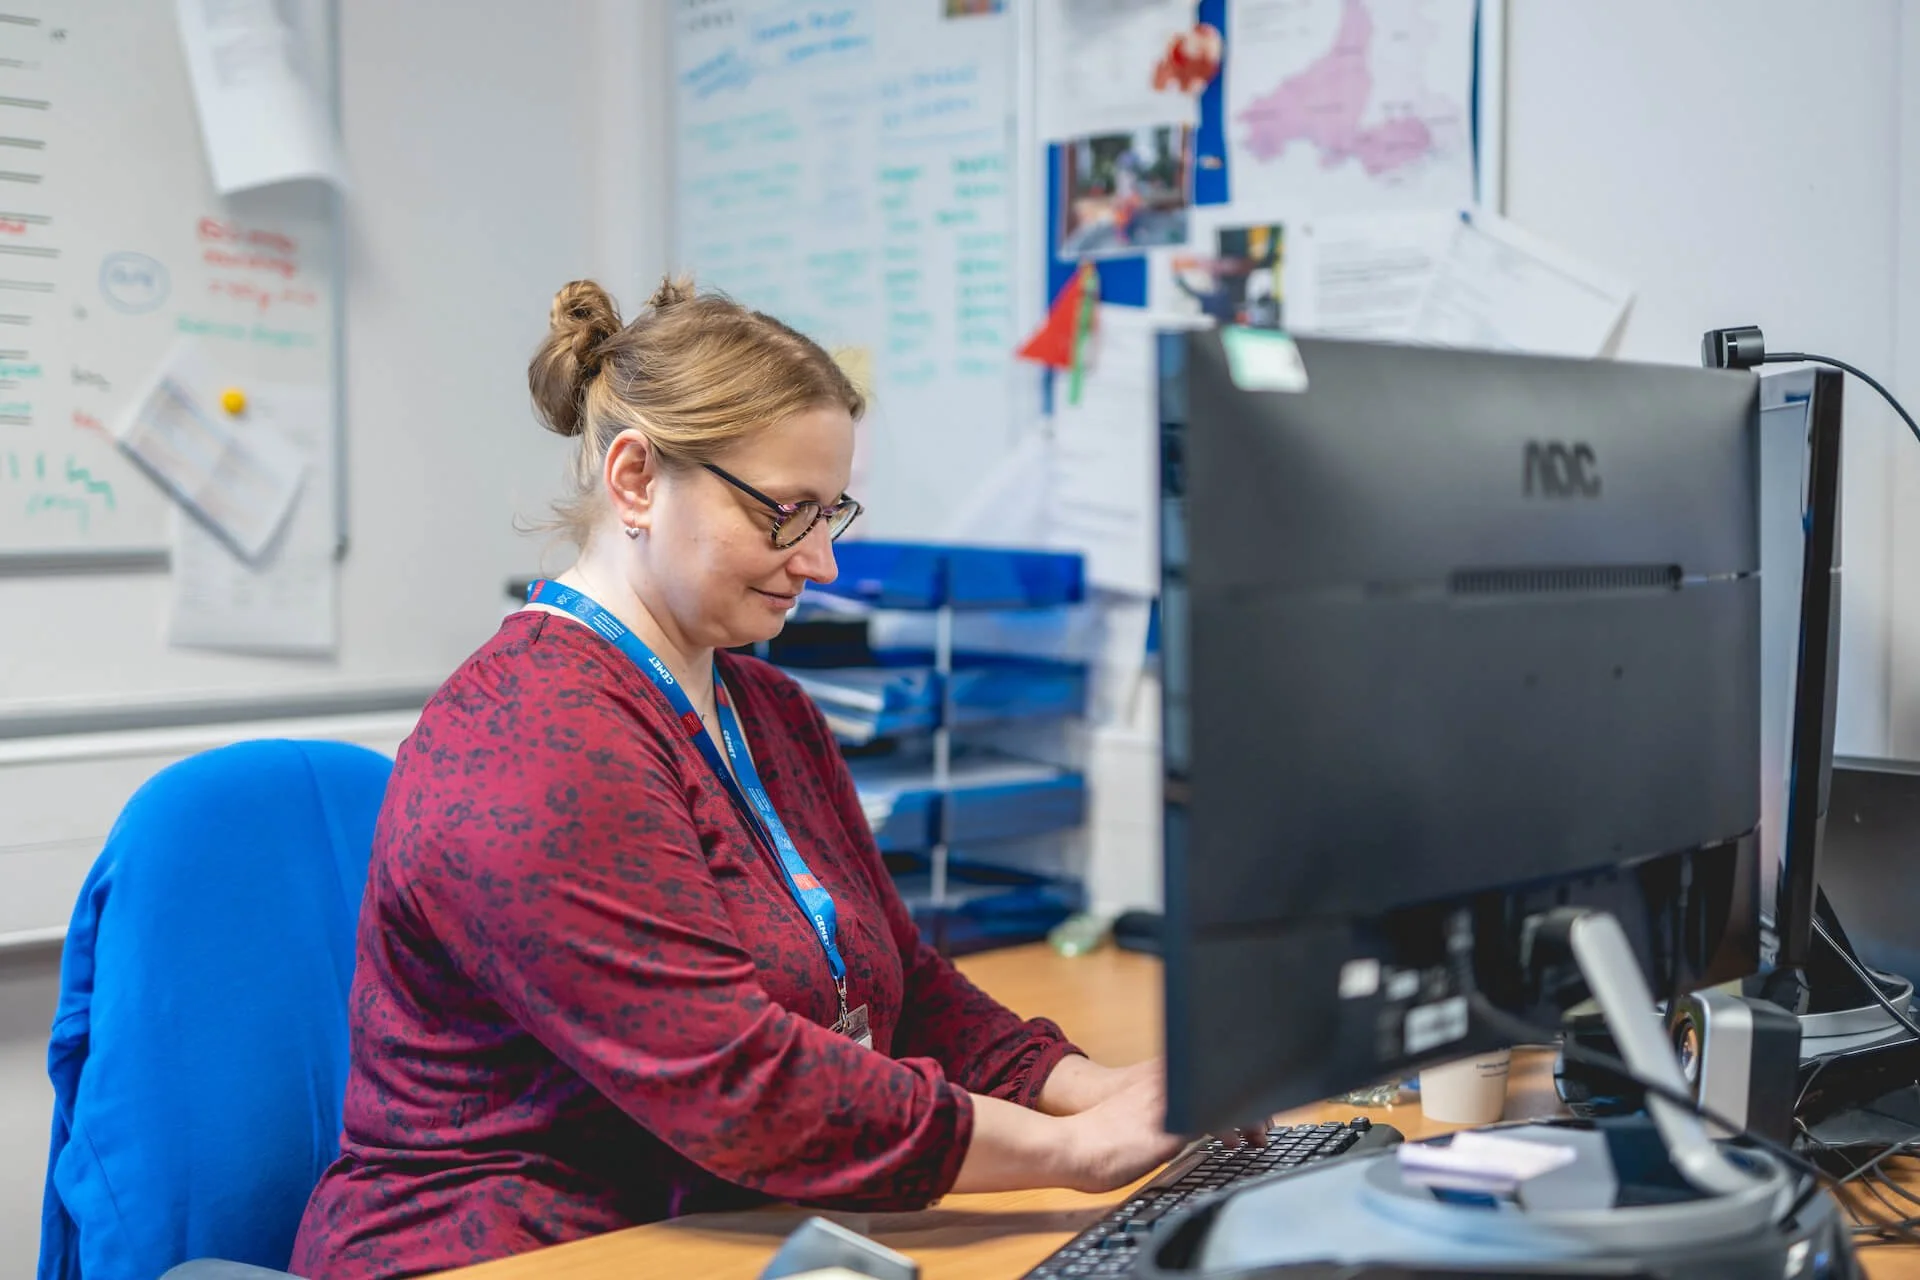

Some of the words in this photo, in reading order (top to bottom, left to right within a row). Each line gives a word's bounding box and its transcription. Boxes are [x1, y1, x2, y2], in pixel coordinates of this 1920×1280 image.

[1522, 440, 1603, 498] AOC
[648, 656, 674, 685] CEMET
[723, 729, 737, 759] CEMET
